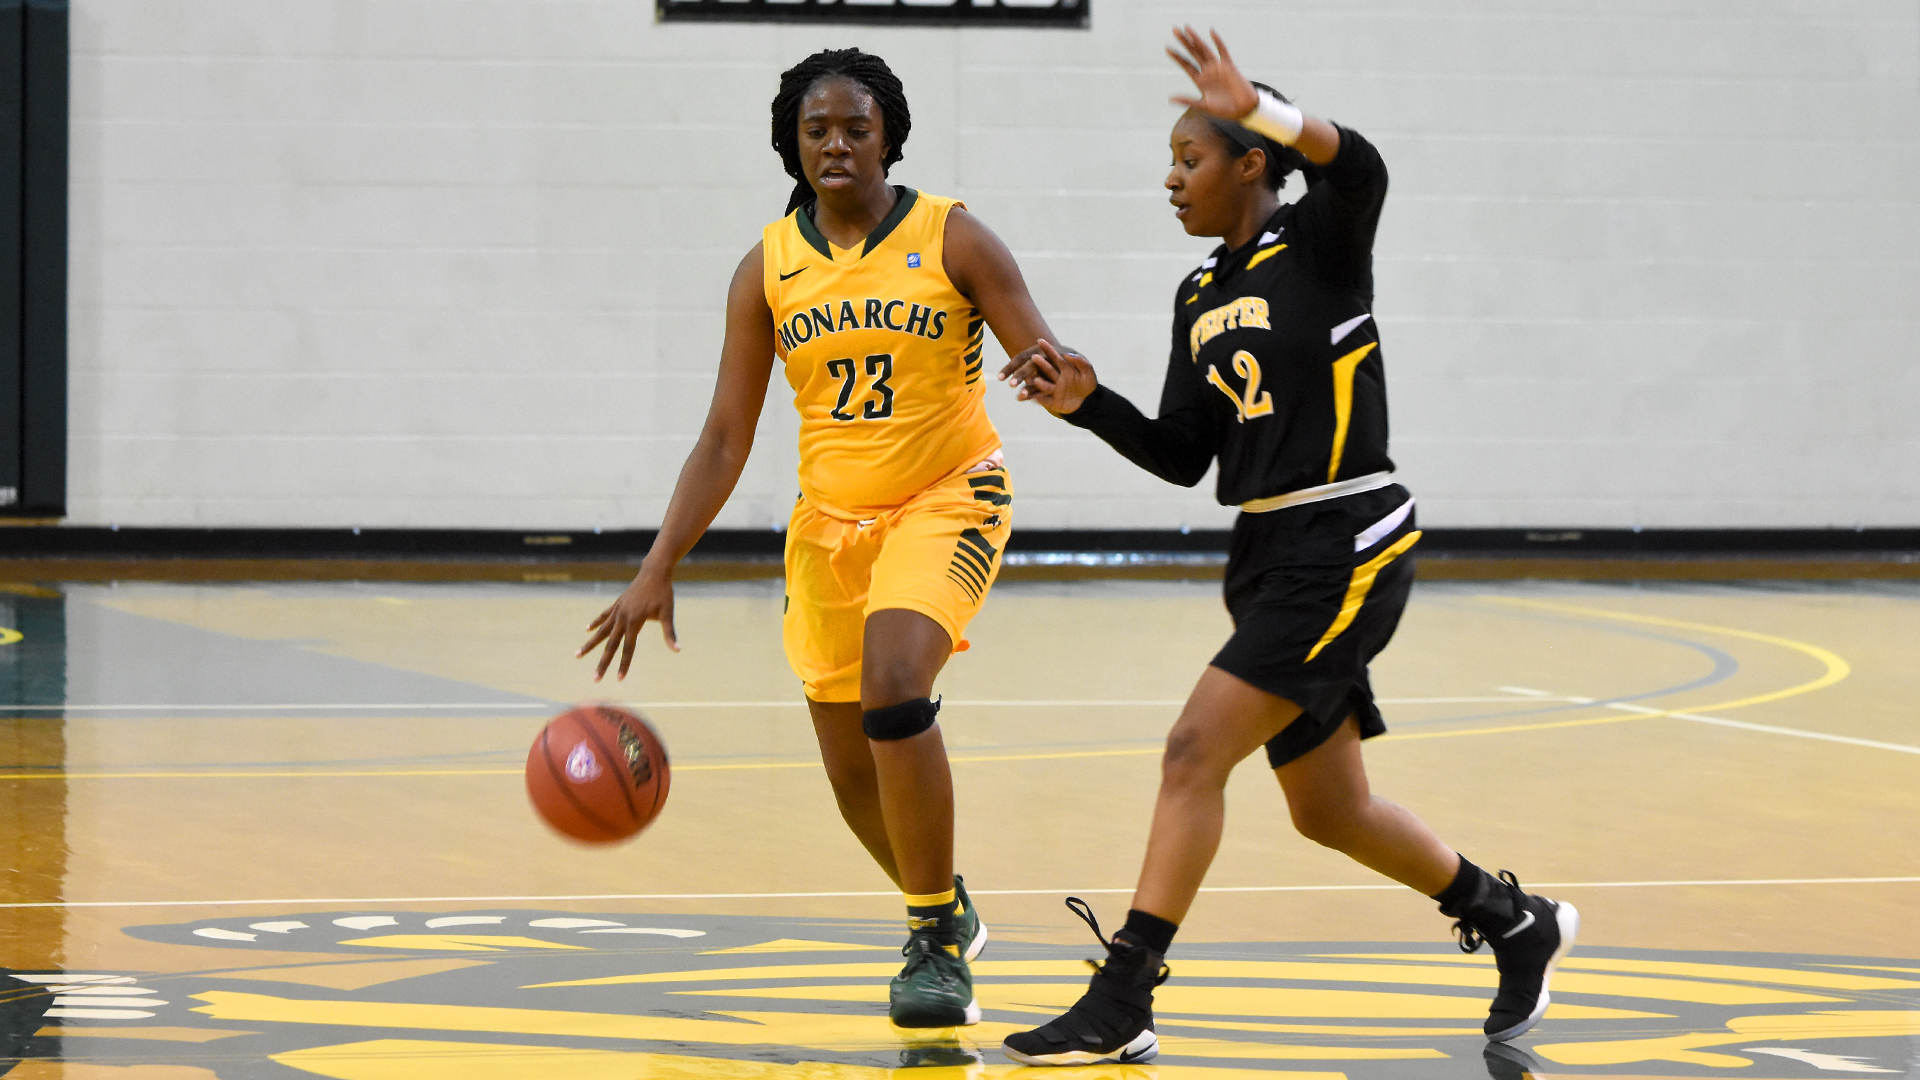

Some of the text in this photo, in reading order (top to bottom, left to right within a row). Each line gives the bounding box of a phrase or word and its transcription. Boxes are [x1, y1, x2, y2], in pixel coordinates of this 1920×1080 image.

[778, 298, 948, 354] MONARCHS
[826, 353, 894, 421] 23
[1205, 350, 1274, 423] 12
